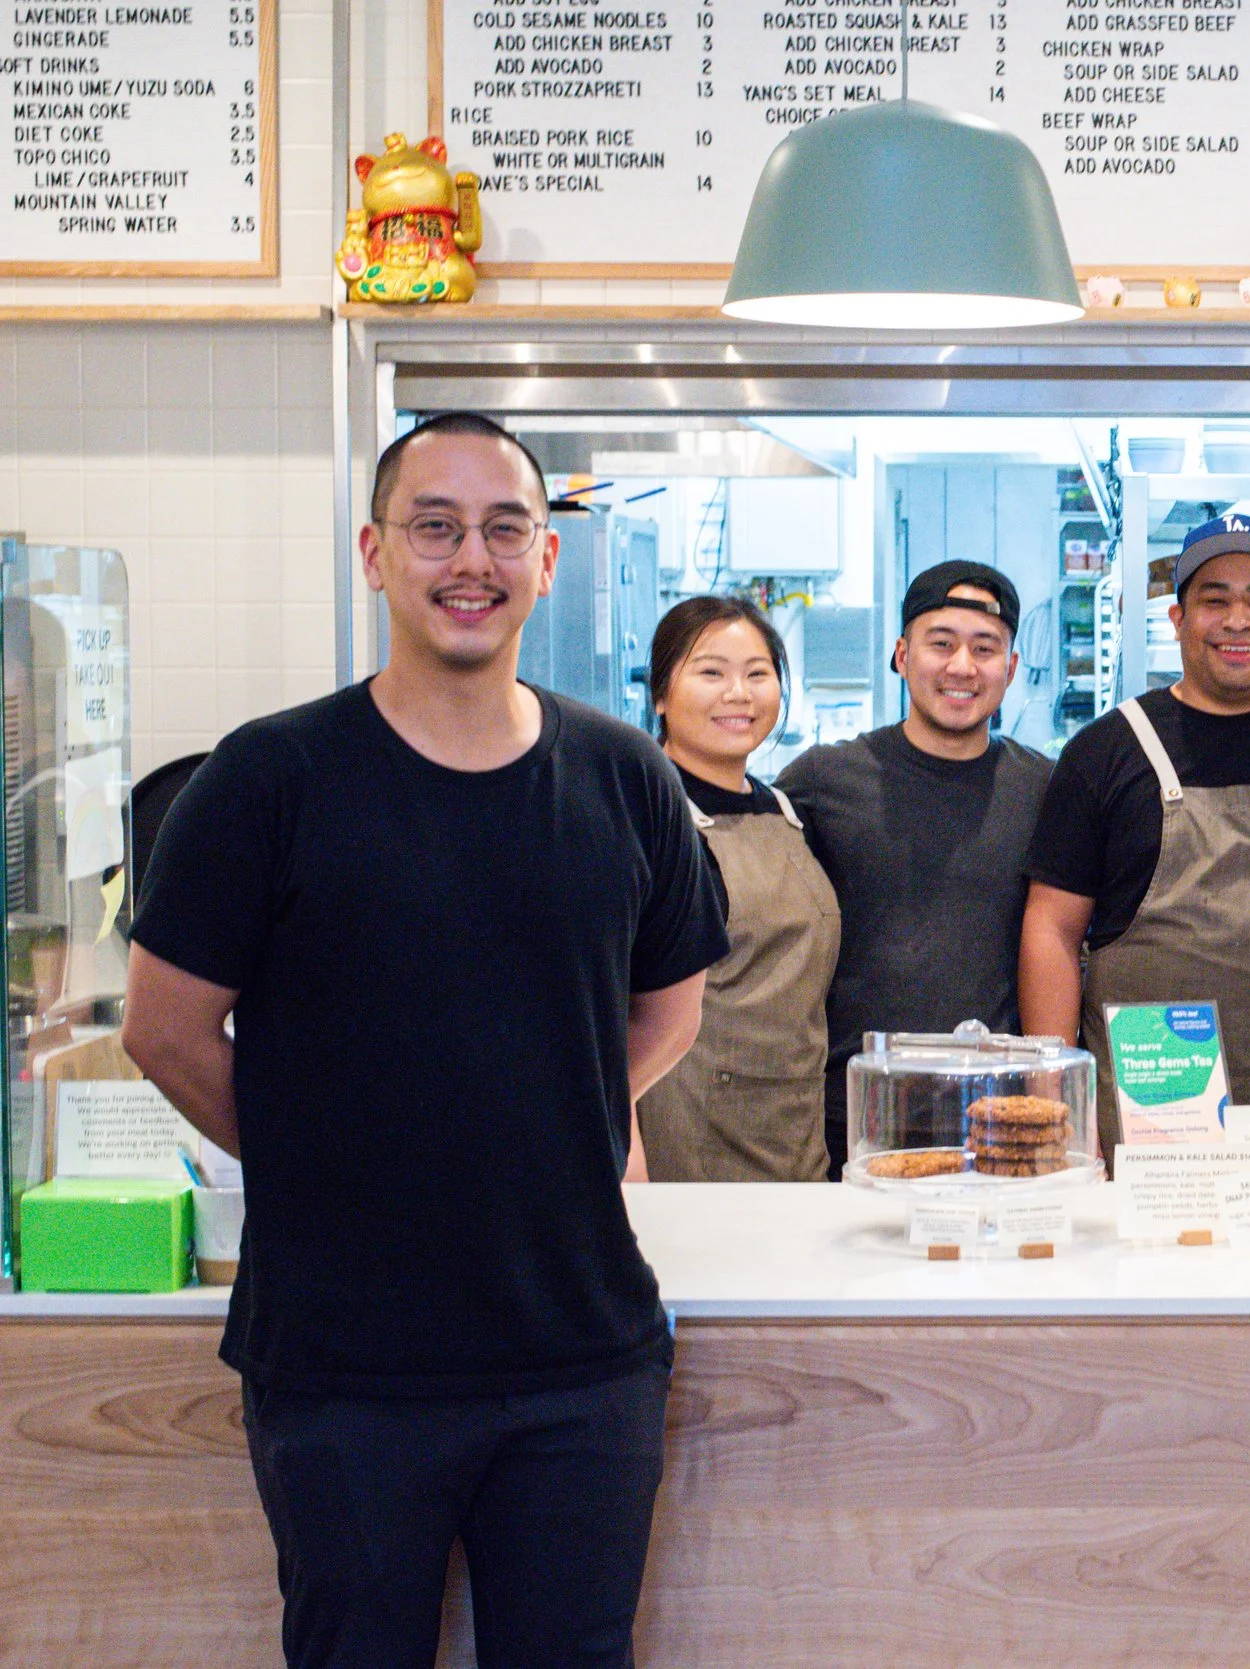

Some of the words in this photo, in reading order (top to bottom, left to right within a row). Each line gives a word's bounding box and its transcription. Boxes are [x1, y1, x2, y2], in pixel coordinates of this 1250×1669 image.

[14, 7, 97, 25] LAVENDER
[105, 7, 192, 26] LEMONADE
[229, 7, 255, 25] 5.5
[473, 11, 516, 29] COLD
[521, 11, 587, 29] SESAME
[593, 11, 668, 29] NOODLES
[763, 12, 838, 30] ROASTED
[928, 13, 968, 31] KALE
[1066, 13, 1099, 32] ADD
[1104, 14, 1189, 33] GRASSFED
[1194, 14, 1237, 33] BEEF
[12, 30, 110, 48] GINGERADE
[229, 30, 255, 48] 5.5
[493, 34, 527, 52] ADD
[531, 34, 603, 52] CHICKEN
[609, 34, 673, 53] BREAST
[1042, 40, 1112, 58] CHICKEN
[1118, 41, 1165, 58] WRAP
[40, 57, 100, 75] DRINKS
[494, 57, 526, 75] ADD
[530, 57, 603, 75] AVOCADO
[784, 58, 817, 76] ADD
[823, 58, 897, 76] AVOCADO
[1063, 63, 1108, 81] SOUP
[1113, 63, 1135, 81] OR
[1141, 64, 1179, 81] SIDE
[1186, 64, 1240, 82] SALAD
[13, 79, 74, 97] KIMINO
[173, 79, 216, 97] SODA
[474, 80, 517, 99] PORK
[521, 80, 641, 99] STROZZAPRETI
[742, 84, 798, 102] YANG'S
[803, 84, 836, 102] SET
[843, 85, 889, 104] MEAL
[1063, 86, 1097, 104] ADD
[1101, 86, 1166, 104] CHEESE
[13, 103, 84, 120] MEXICAN
[89, 102, 130, 120] COKE
[229, 101, 256, 119] 3.5
[450, 106, 493, 124] RICE
[1042, 112, 1085, 129] BEEF
[1091, 112, 1138, 129] WRAP
[14, 125, 53, 143] DIET
[60, 125, 103, 143] COKE
[230, 125, 256, 143] 2.5
[472, 129, 540, 147] BRAISED
[546, 129, 589, 147] PORK
[596, 129, 634, 147] RICE
[14, 148, 57, 167] TOPO
[60, 148, 111, 166] CHICO
[230, 148, 256, 166] 3.5
[492, 151, 543, 169] WHITE
[547, 152, 568, 169] OR
[573, 151, 665, 169] MULTIGRAIN
[535, 174, 604, 193] SPECIAL
[14, 193, 97, 211] MOUNTAIN
[104, 193, 168, 210] VALLEY
[58, 216, 116, 233] SPRING
[123, 216, 177, 233] WATER
[231, 216, 256, 233] 3.5
[76, 628, 97, 652] PICK
[98, 628, 112, 651] UP
[74, 663, 95, 686] TAKE
[96, 662, 114, 686] OUT
[85, 697, 107, 721] HERE
[1119, 1042, 1135, 1053] We
[1138, 1042, 1162, 1053] serve
[1121, 1057, 1156, 1071] Three
[1158, 1056, 1191, 1069] Gems
[1191, 1055, 1213, 1068] Tea
[1125, 1153, 1177, 1162] PERSIMMON
[1186, 1153, 1208, 1161] KALE
[1209, 1152, 1238, 1161] SALAD
